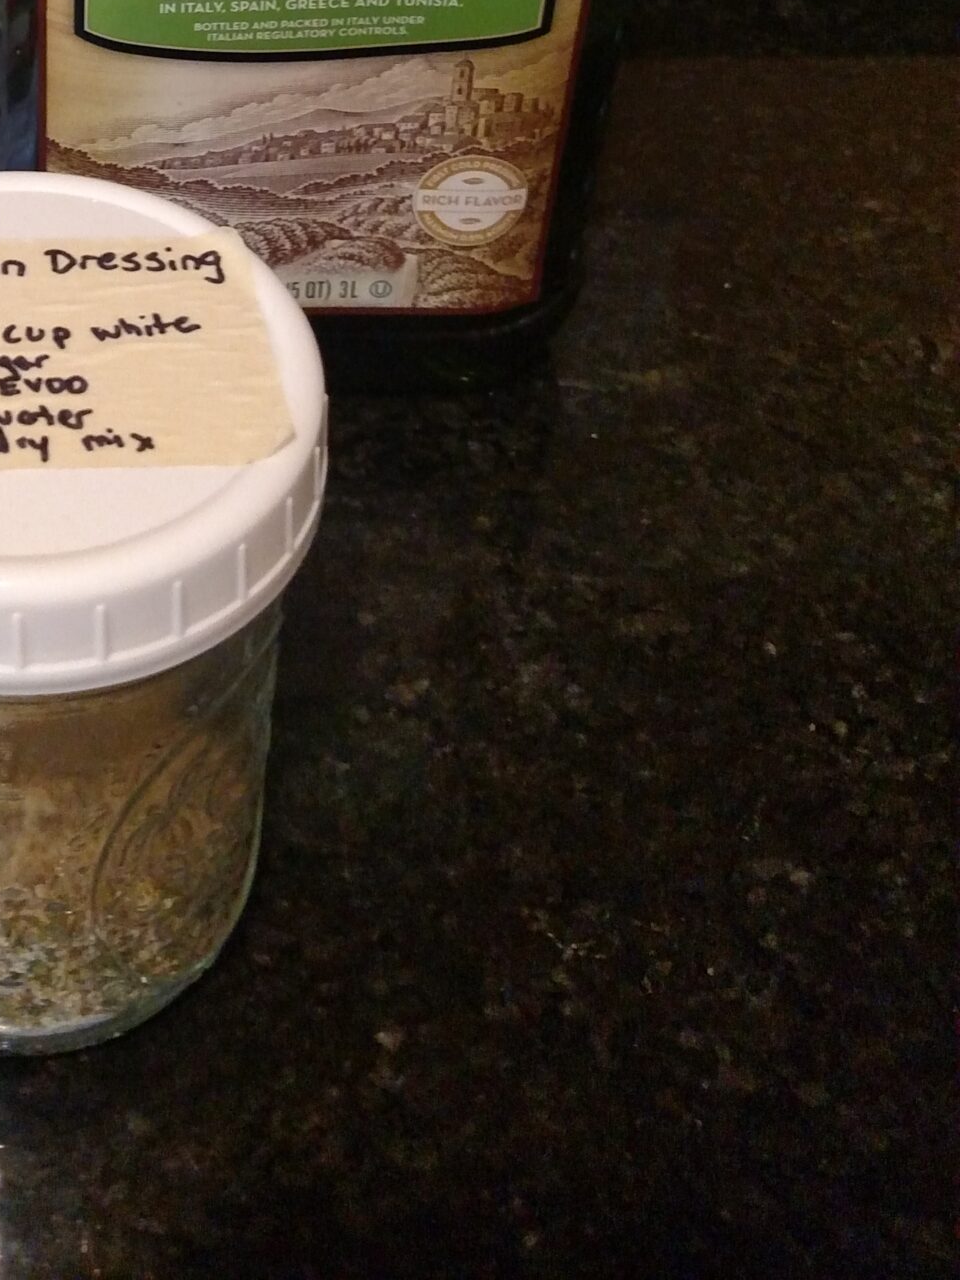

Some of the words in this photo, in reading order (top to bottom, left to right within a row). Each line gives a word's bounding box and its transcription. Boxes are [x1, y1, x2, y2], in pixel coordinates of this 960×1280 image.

[159, 3, 176, 14] IN
[180, 1, 226, 13] ITALY,
[230, 0, 281, 12] SPAIN,
[194, 21, 249, 31] BOTTLED
[251, 20, 278, 30] AND
[280, 18, 329, 30] PACKED
[331, 18, 345, 27] IN
[346, 16, 380, 26] ITALY
[382, 15, 425, 25] UNDER
[207, 32, 253, 41] ITALIAN
[256, 29, 335, 40] REGULATORY
[422, 195, 459, 206] RICH
[464, 194, 523, 207] FLAVOR
[43, 247, 225, 284] Dressing
[340, 281, 358, 299] 3L
[2, 324, 71, 350] cup
[90, 313, 202, 342] white
[82, 428, 155, 453] mix
